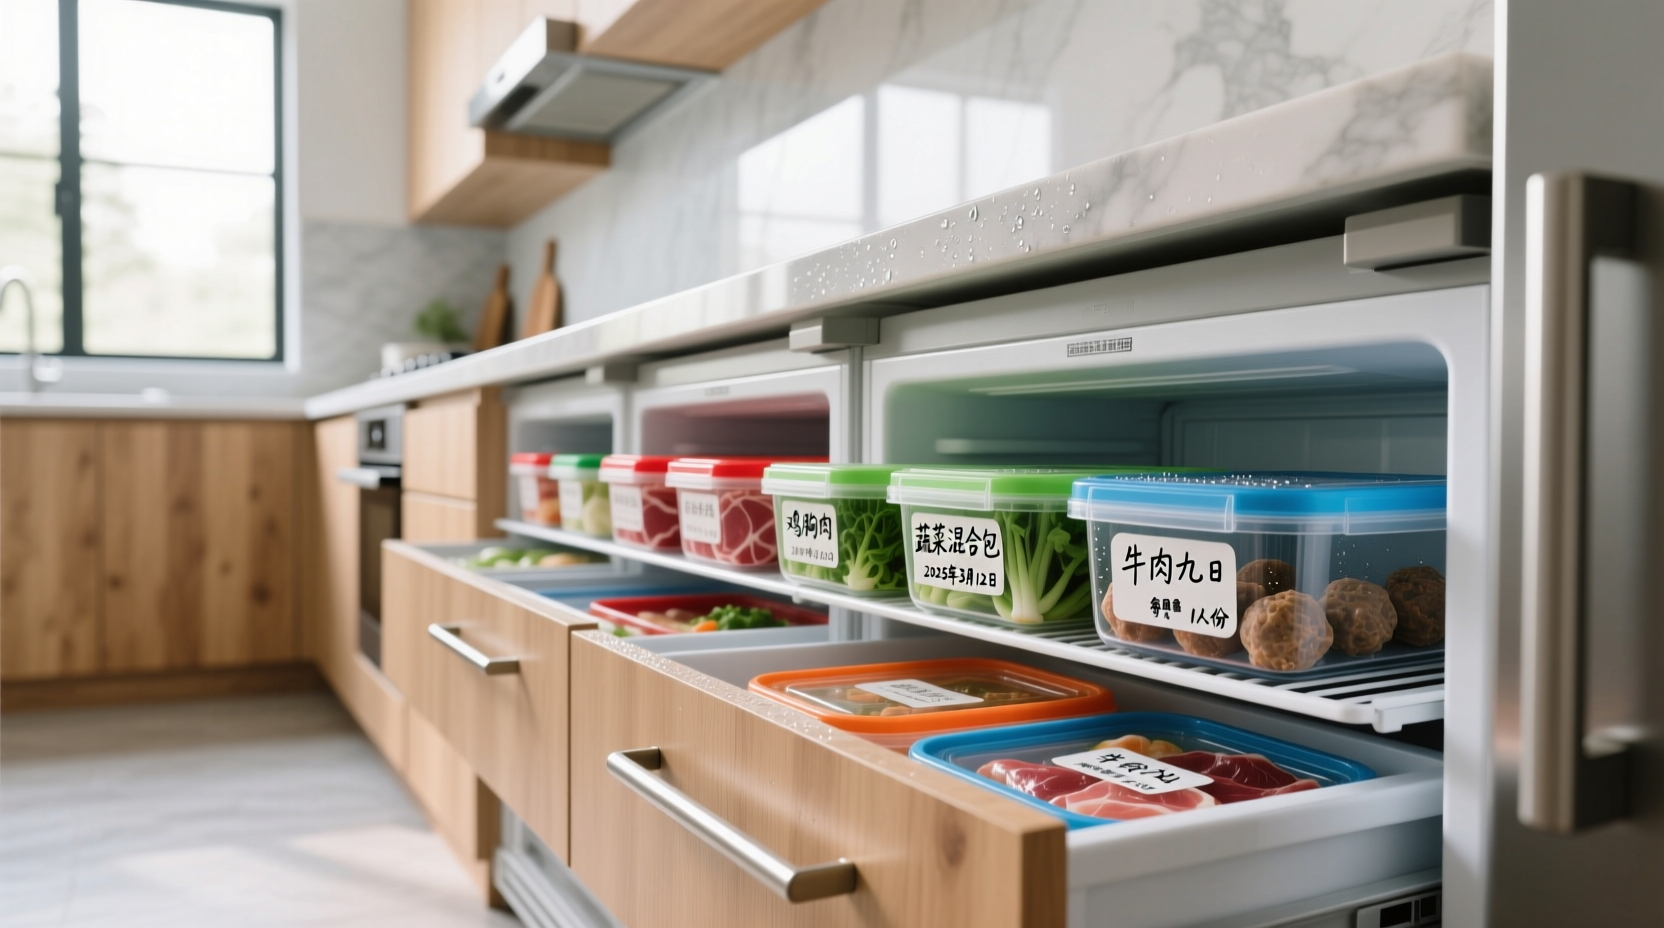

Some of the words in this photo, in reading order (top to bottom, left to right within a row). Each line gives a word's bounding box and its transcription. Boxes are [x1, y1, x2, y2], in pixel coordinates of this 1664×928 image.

[914, 522, 1000, 559] 蔬菜混合包
[923, 564, 997, 587] 2025年3月12日
[1122, 543, 1222, 586] 牛肉九日
